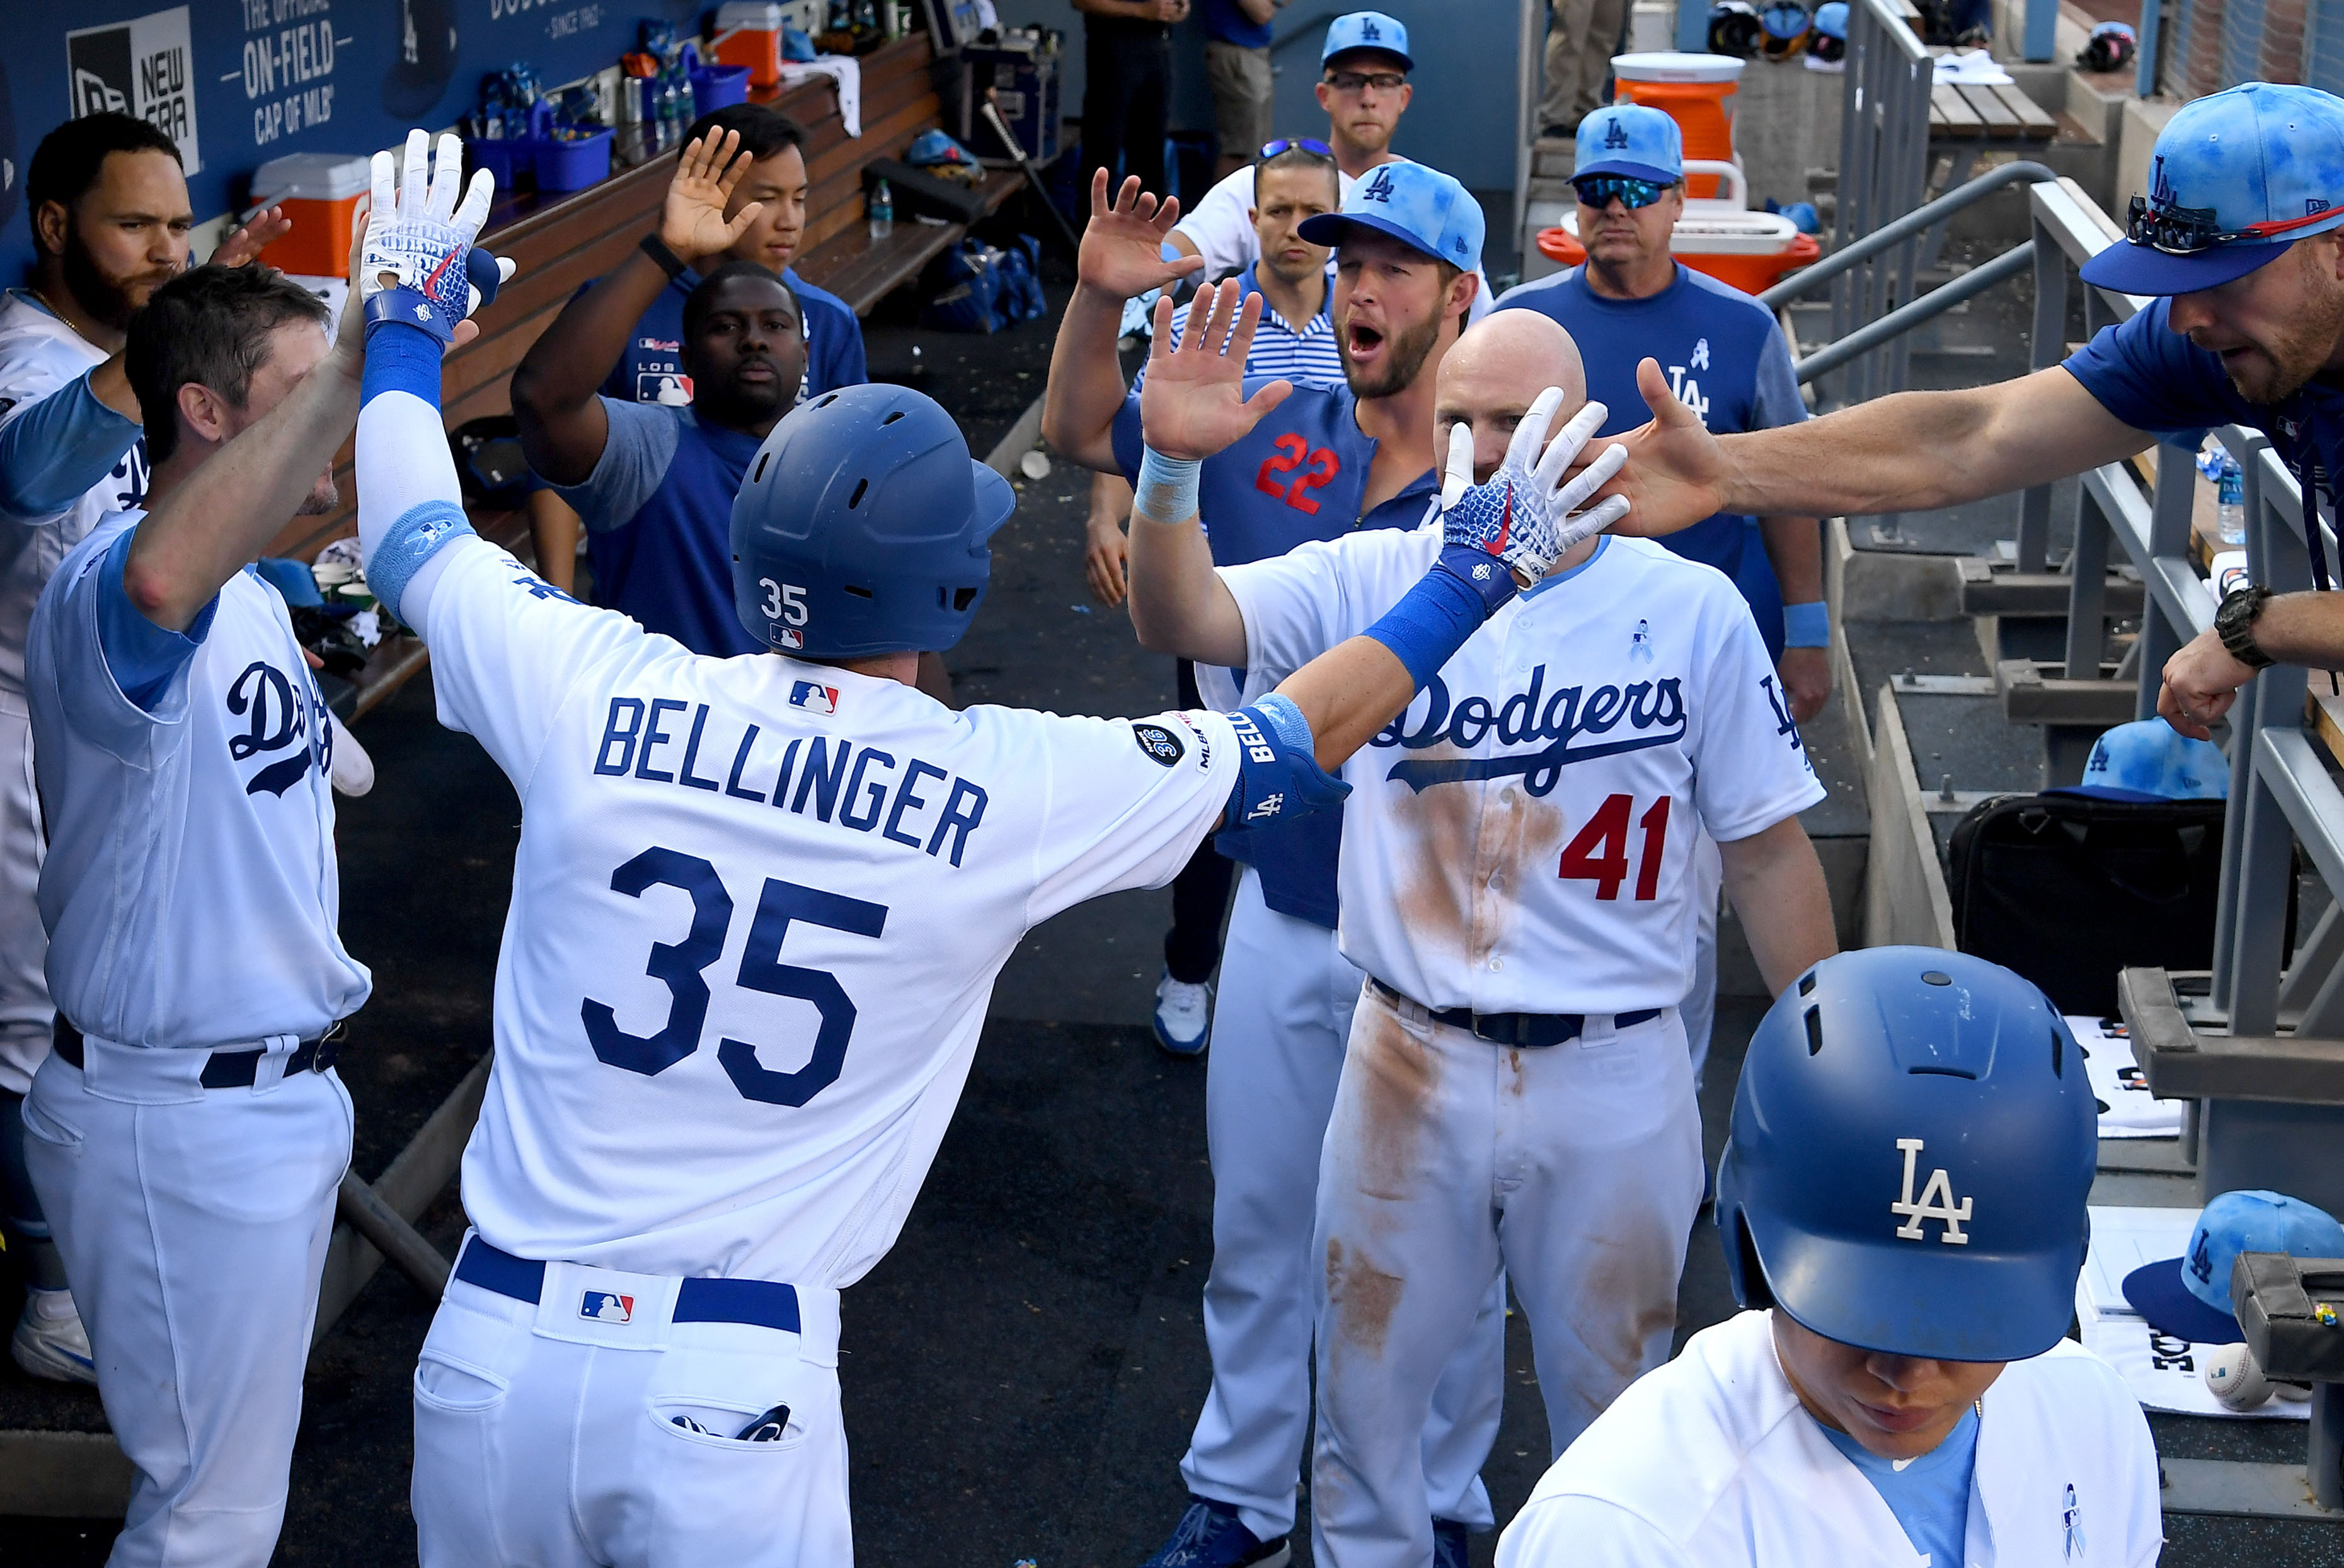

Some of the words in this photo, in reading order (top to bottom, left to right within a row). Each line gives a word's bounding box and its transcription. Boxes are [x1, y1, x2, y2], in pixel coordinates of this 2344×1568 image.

[1362, 17, 1381, 41] LA
[141, 46, 184, 103] NEW
[243, 20, 334, 100] ON-FIELD
[254, 102, 282, 146] CAP
[285, 94, 301, 135] OF
[1605, 117, 1628, 149] LA
[1364, 166, 1394, 203] LA
[638, 362, 675, 372] LOS
[1255, 432, 1340, 515] 22
[759, 578, 808, 626] 35
[1137, 730, 1154, 753] NEWK
[1144, 729, 1177, 757] 36
[1370, 663, 1687, 798] Dodgers
[594, 697, 989, 869] BELLINGER
[1248, 793, 1284, 820] LA
[1558, 793, 1670, 901] 41
[581, 846, 889, 1107] 35
[1891, 1138, 1973, 1245] LA
[2190, 1228, 2213, 1284] LA
